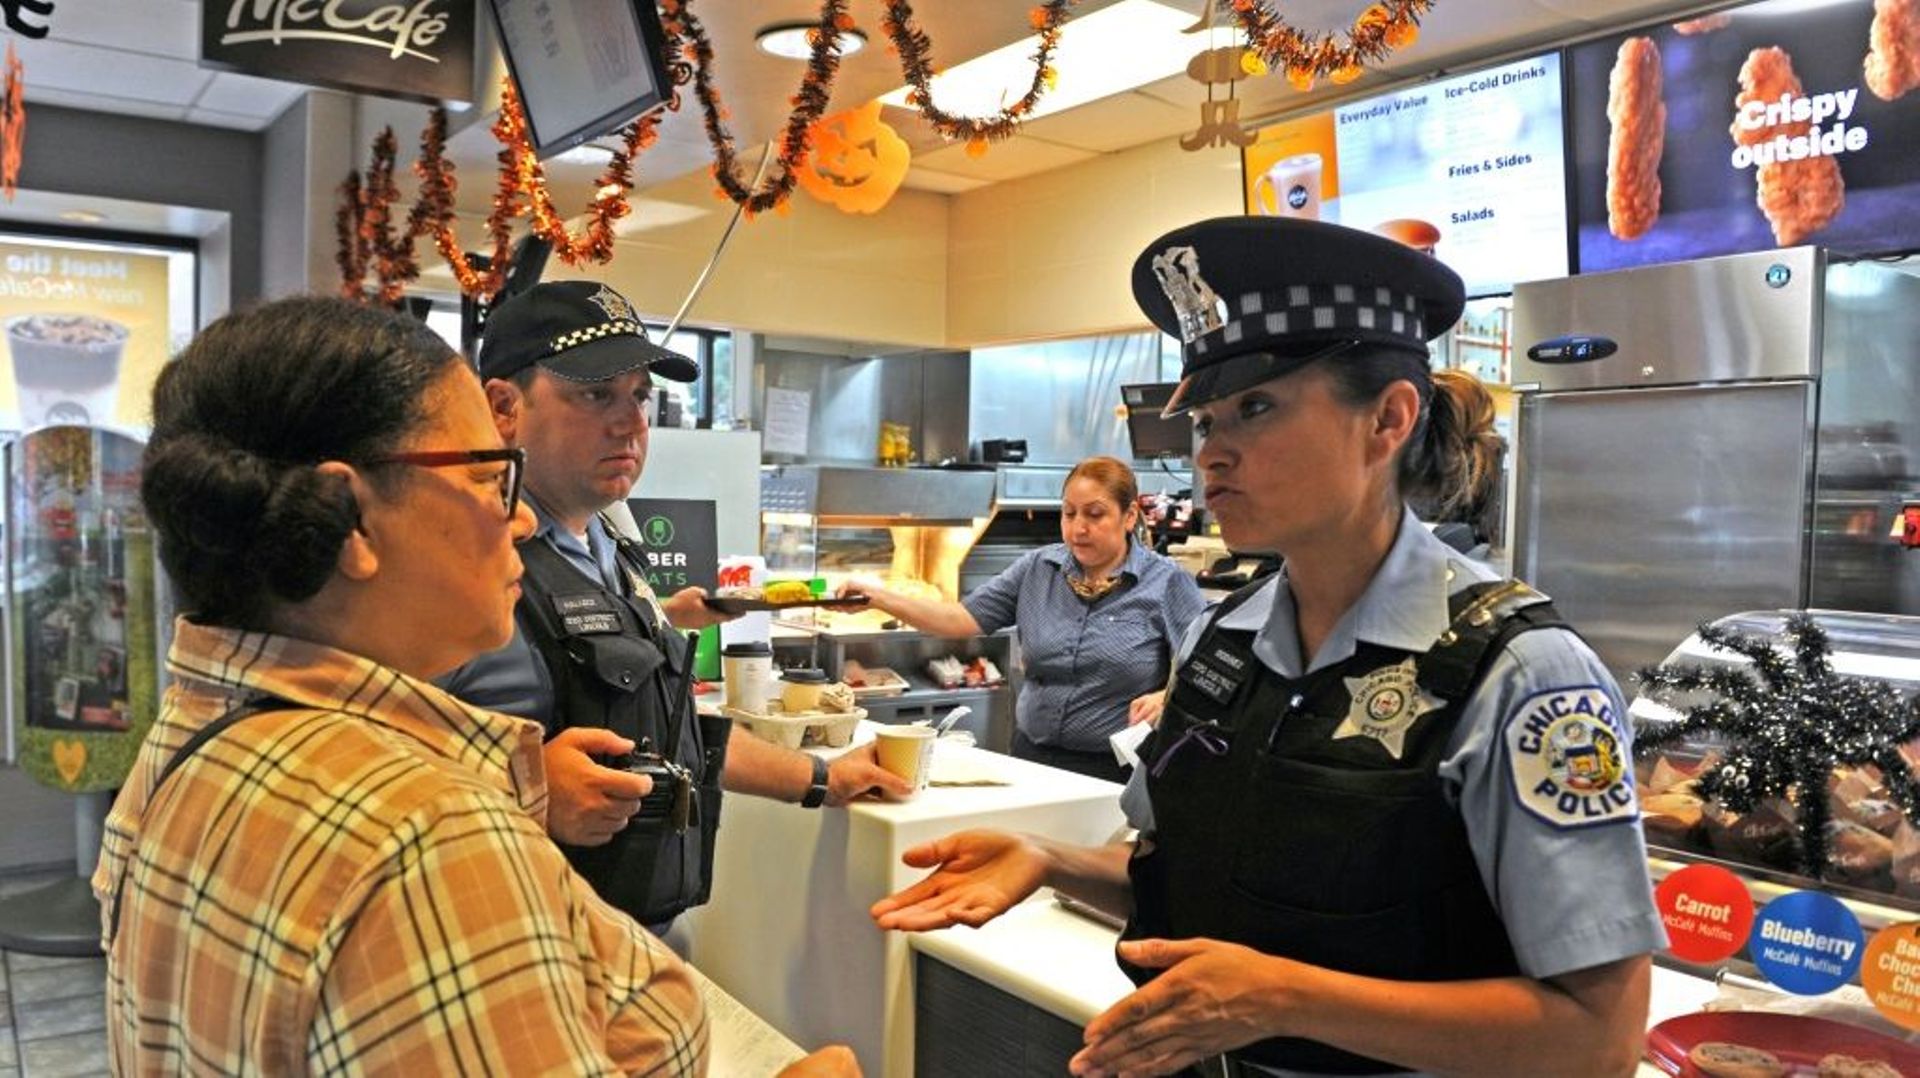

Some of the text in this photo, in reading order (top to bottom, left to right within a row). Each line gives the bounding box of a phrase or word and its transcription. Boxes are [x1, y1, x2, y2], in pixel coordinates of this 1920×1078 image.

[1445, 65, 1546, 99] Ice-Cold Drinks
[1340, 95, 1428, 125] Everyday Value
[1741, 88, 1858, 131] Crispy
[1731, 122, 1868, 169] outside
[1448, 154, 1532, 178] Fries & Sides
[1451, 207, 1495, 224] Salads
[646, 551, 687, 567] BER
[649, 571, 687, 586] ATS
[1518, 696, 1617, 754] CHICAG
[1533, 776, 1634, 817] POLIC
[1675, 893, 1731, 924] Carrot
[1761, 919, 1856, 961] Blueberry
[1804, 955, 1843, 976] Muffins
[1879, 952, 1920, 979] Choc
